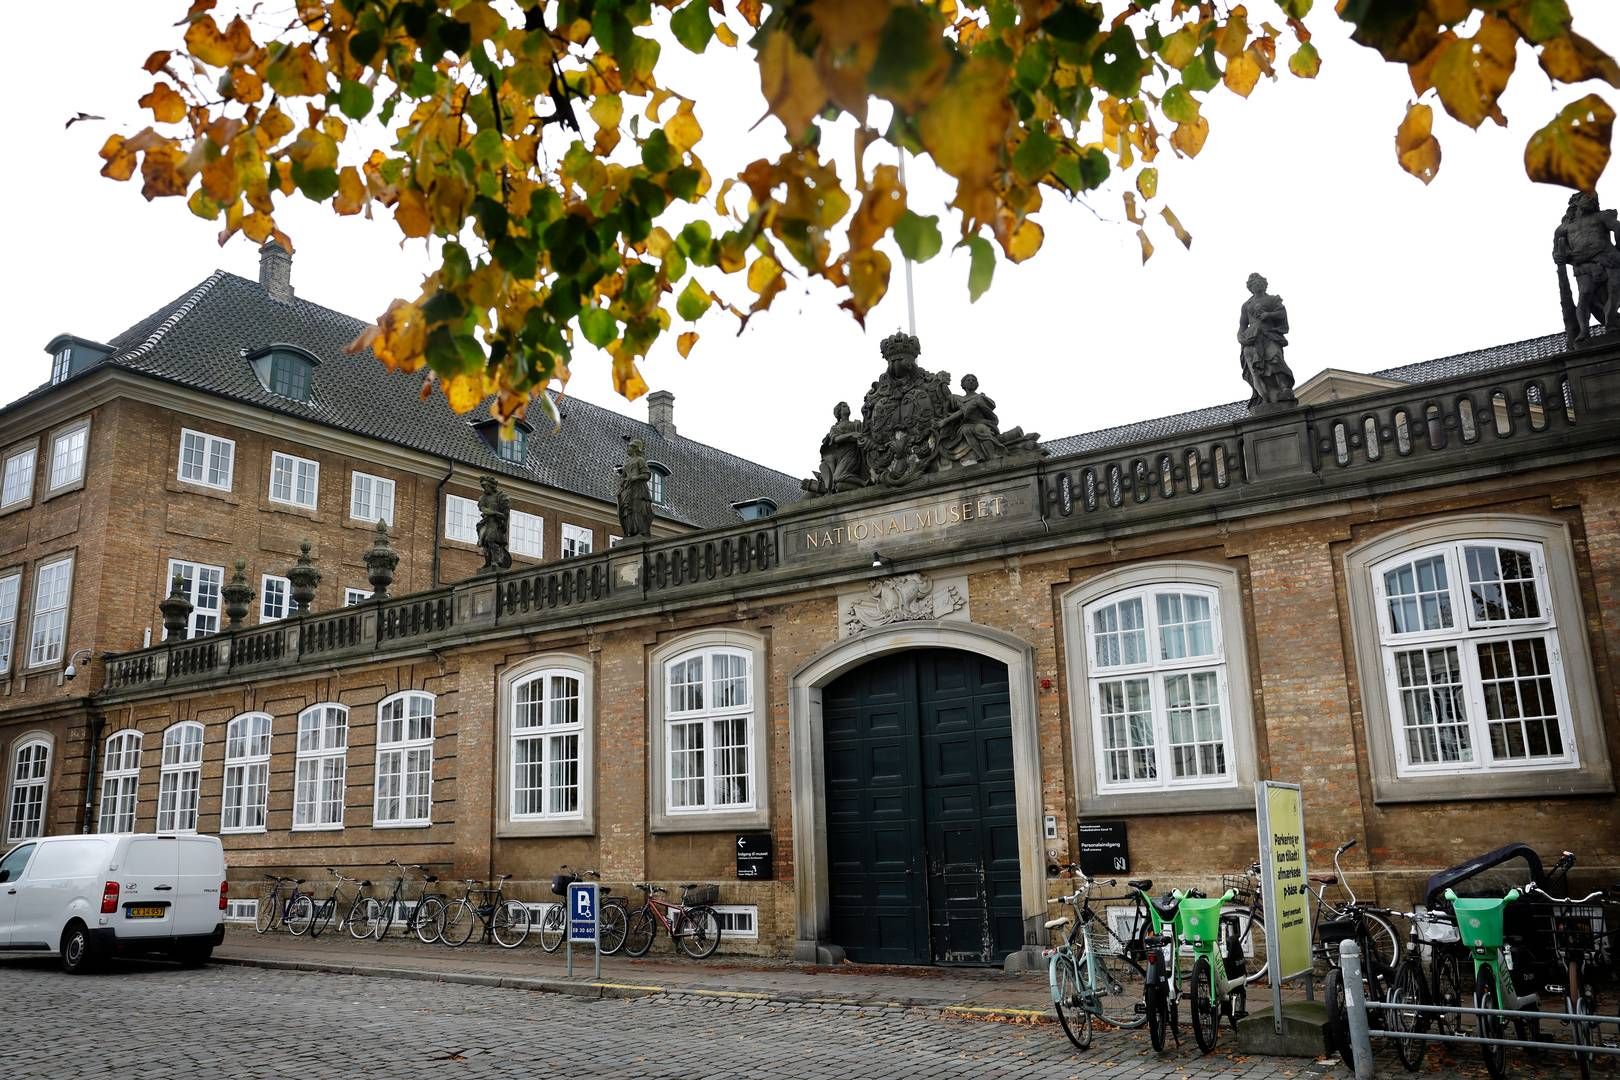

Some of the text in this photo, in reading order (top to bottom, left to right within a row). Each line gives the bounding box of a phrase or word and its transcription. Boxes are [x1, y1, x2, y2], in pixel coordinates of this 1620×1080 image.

[806, 496, 1004, 550] NATIONALMUSEET
[1274, 833, 1295, 848] Parkering
[1276, 850, 1285, 863] kun
